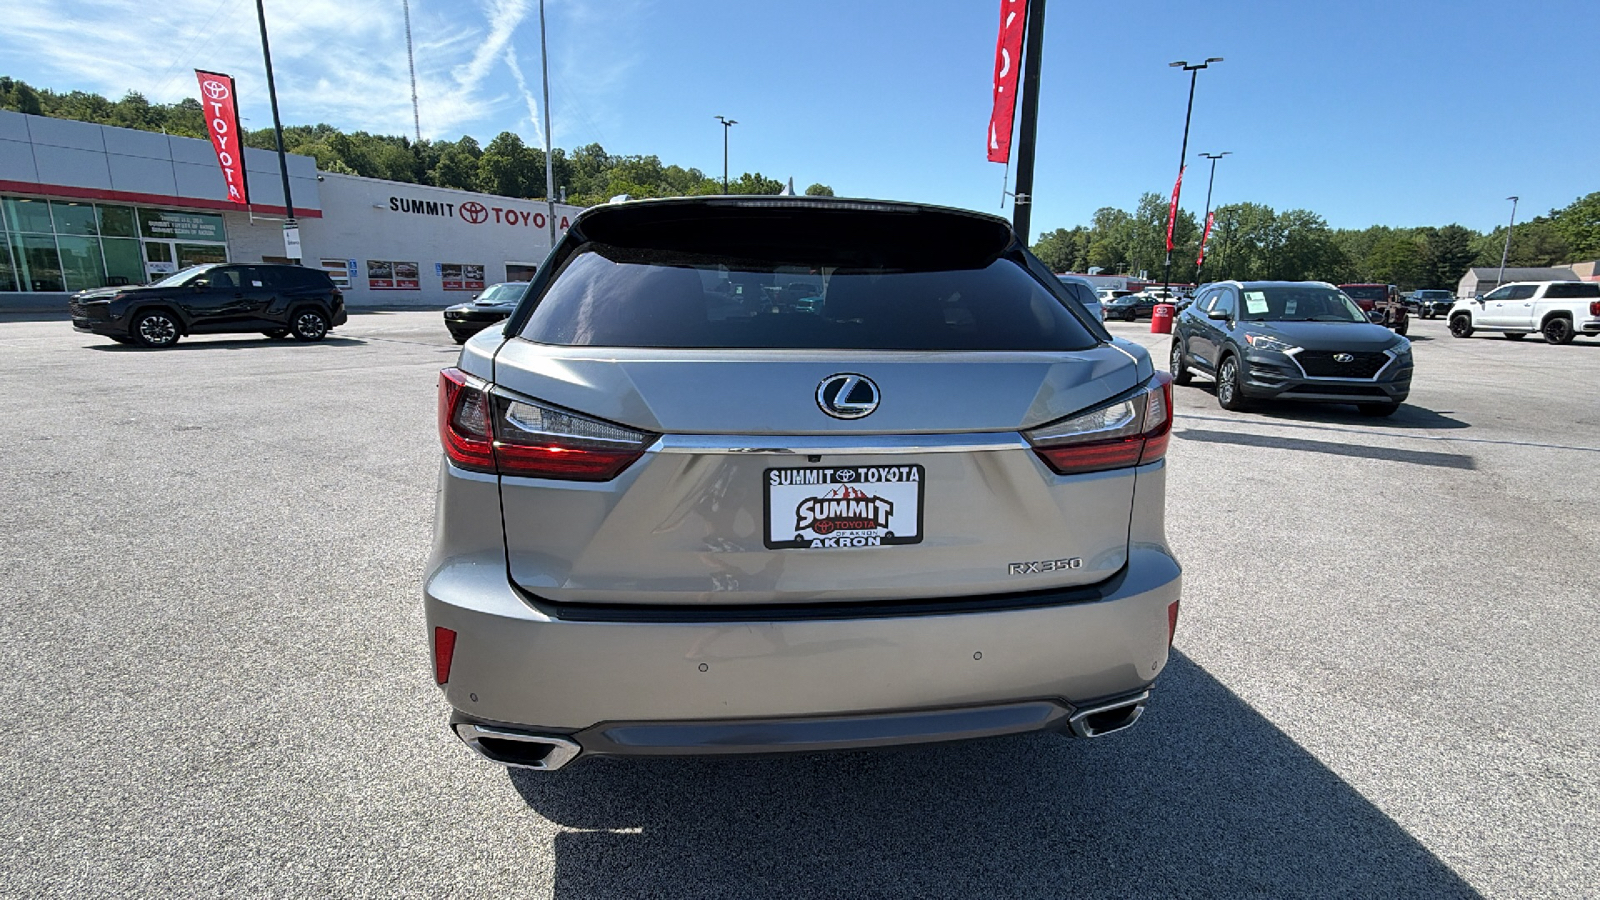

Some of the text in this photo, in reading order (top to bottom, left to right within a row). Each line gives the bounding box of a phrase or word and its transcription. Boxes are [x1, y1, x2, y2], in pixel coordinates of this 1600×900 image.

[210, 101, 240, 199] TOYOTA
[389, 196, 570, 230] SUMMIT TOYOA
[769, 466, 920, 486] SUMMIT TOYOTA
[799, 499, 891, 528] SUMMIT
[834, 520, 876, 529] TOYOTA
[810, 536, 881, 549] AKRON
